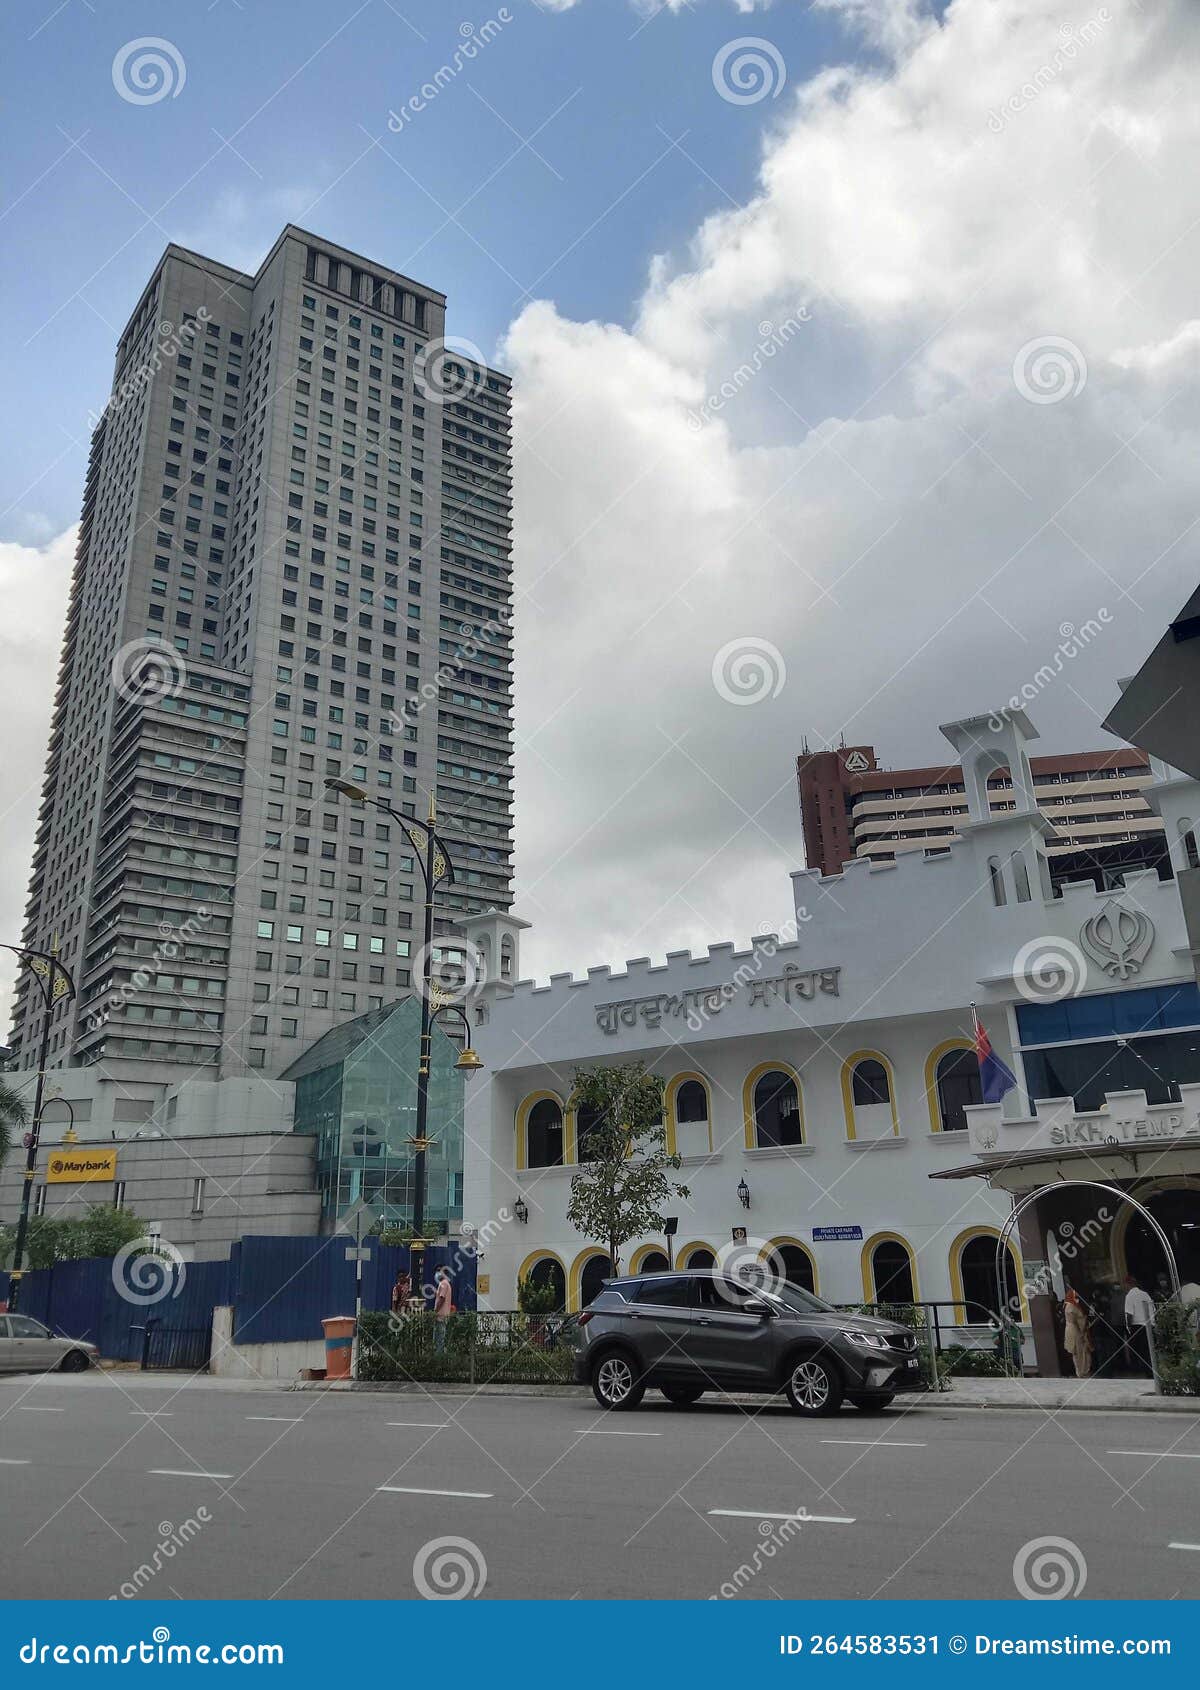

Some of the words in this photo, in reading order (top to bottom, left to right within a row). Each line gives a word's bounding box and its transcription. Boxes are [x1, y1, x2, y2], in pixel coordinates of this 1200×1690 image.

[1050, 1120, 1103, 1145] SIKH
[1116, 1113, 1200, 1139] TEMPL
[63, 1160, 111, 1172] Maybank
